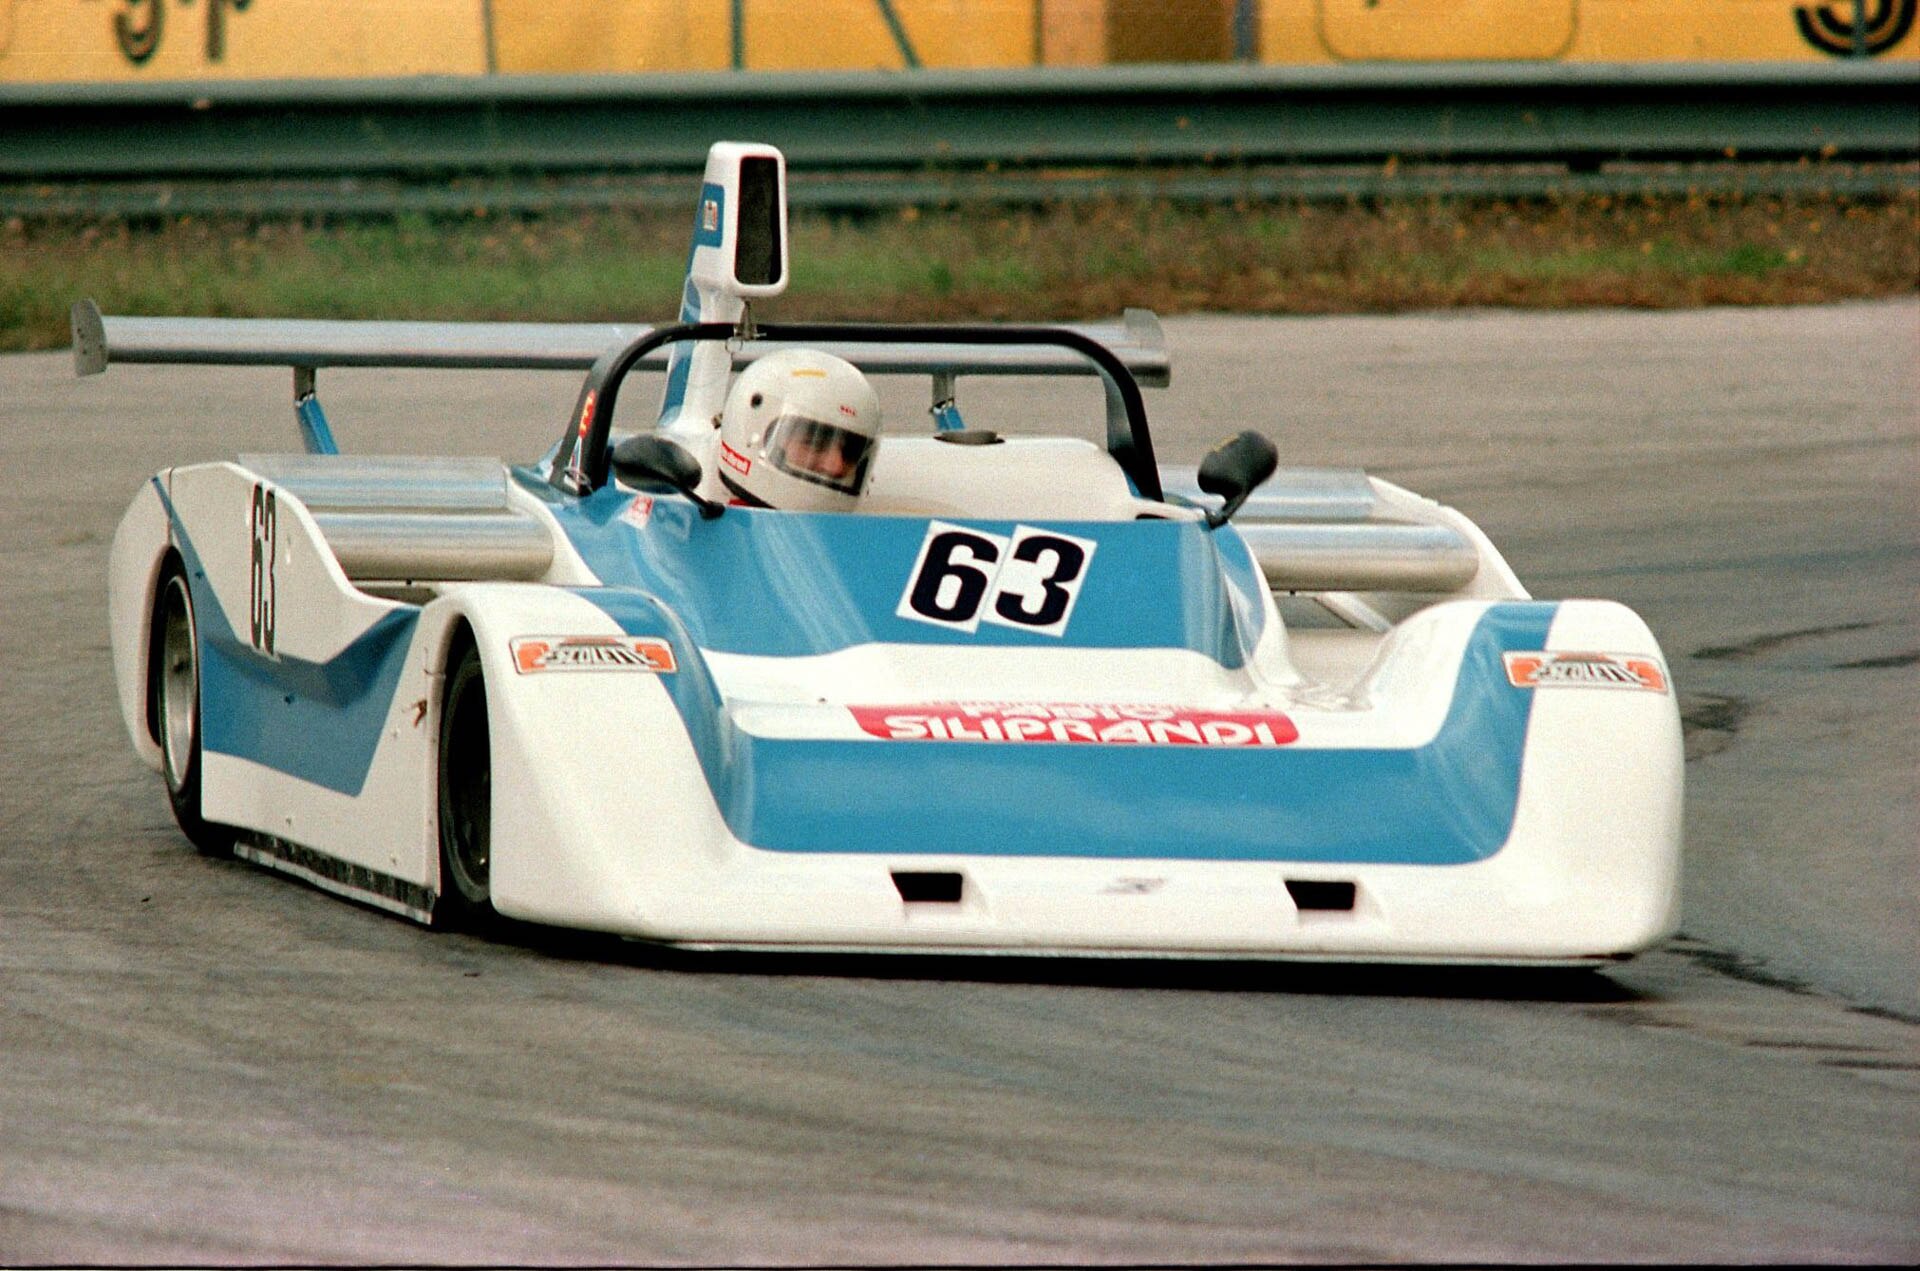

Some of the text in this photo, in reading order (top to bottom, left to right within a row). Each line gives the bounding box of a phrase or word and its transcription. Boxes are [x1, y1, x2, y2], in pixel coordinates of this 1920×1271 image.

[251, 482, 276, 656] 63
[909, 531, 1085, 626] 63
[886, 715, 1277, 746] SILIPRANDI
